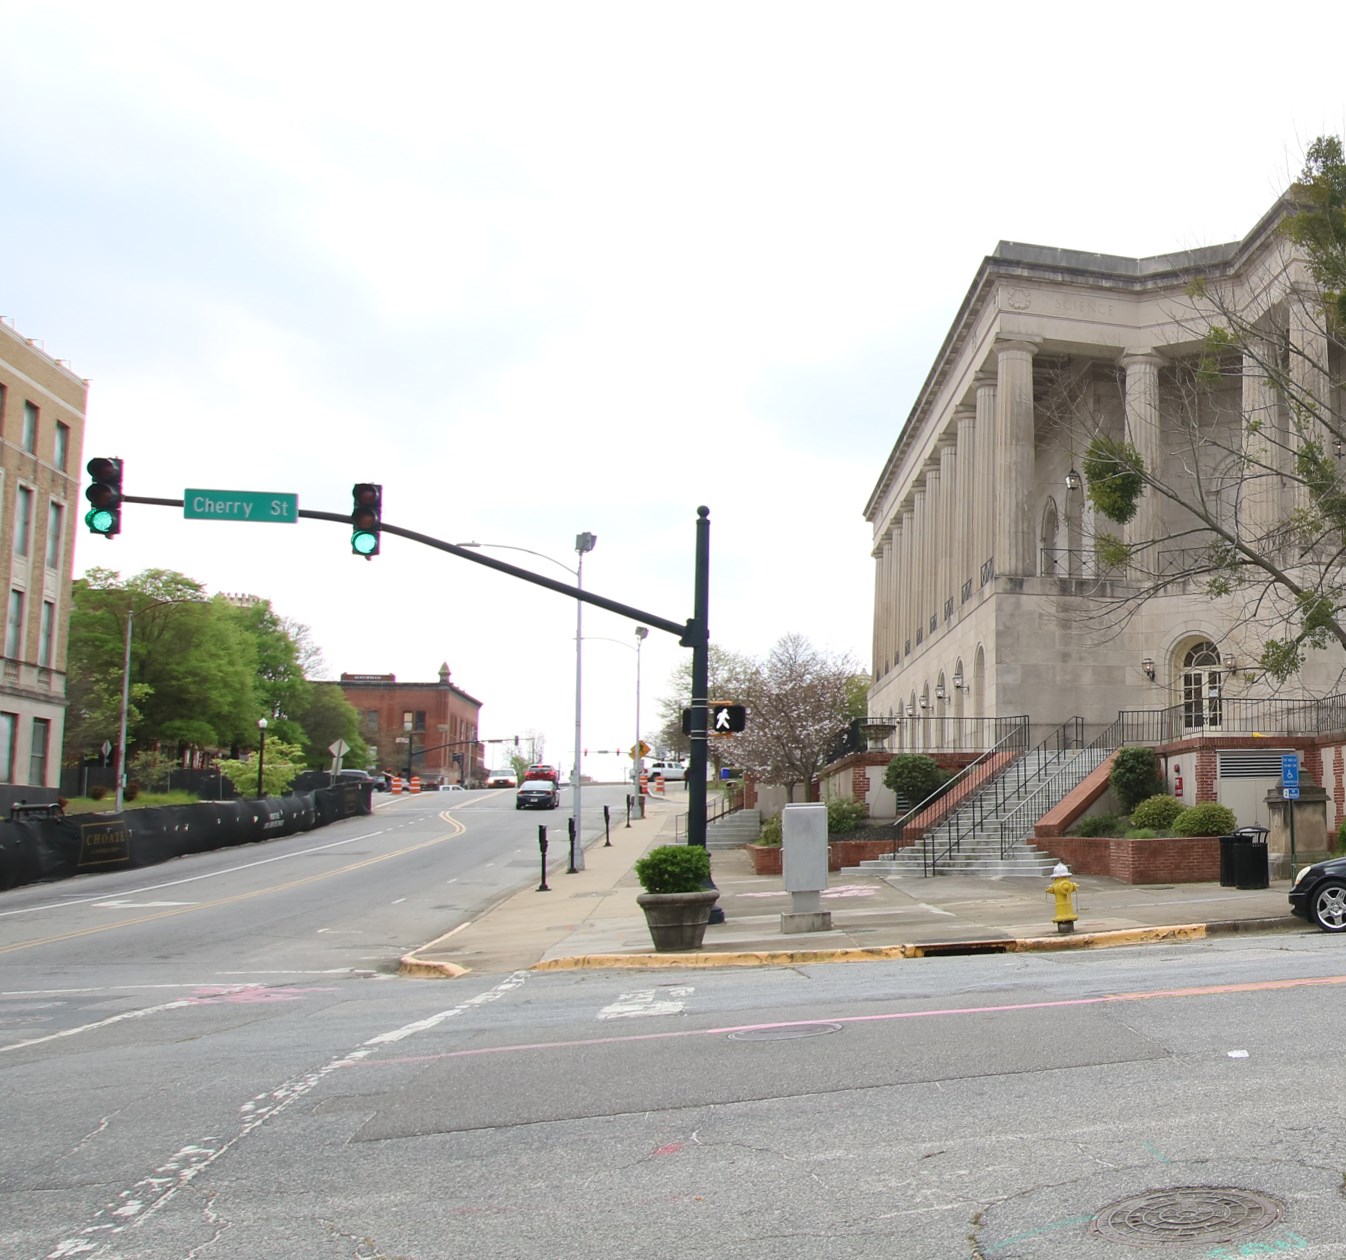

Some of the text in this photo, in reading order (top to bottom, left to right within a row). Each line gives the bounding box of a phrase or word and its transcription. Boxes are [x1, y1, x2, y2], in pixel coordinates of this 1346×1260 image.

[1055, 297, 1113, 316] SCIENCE
[193, 496, 289, 518] Cherry St
